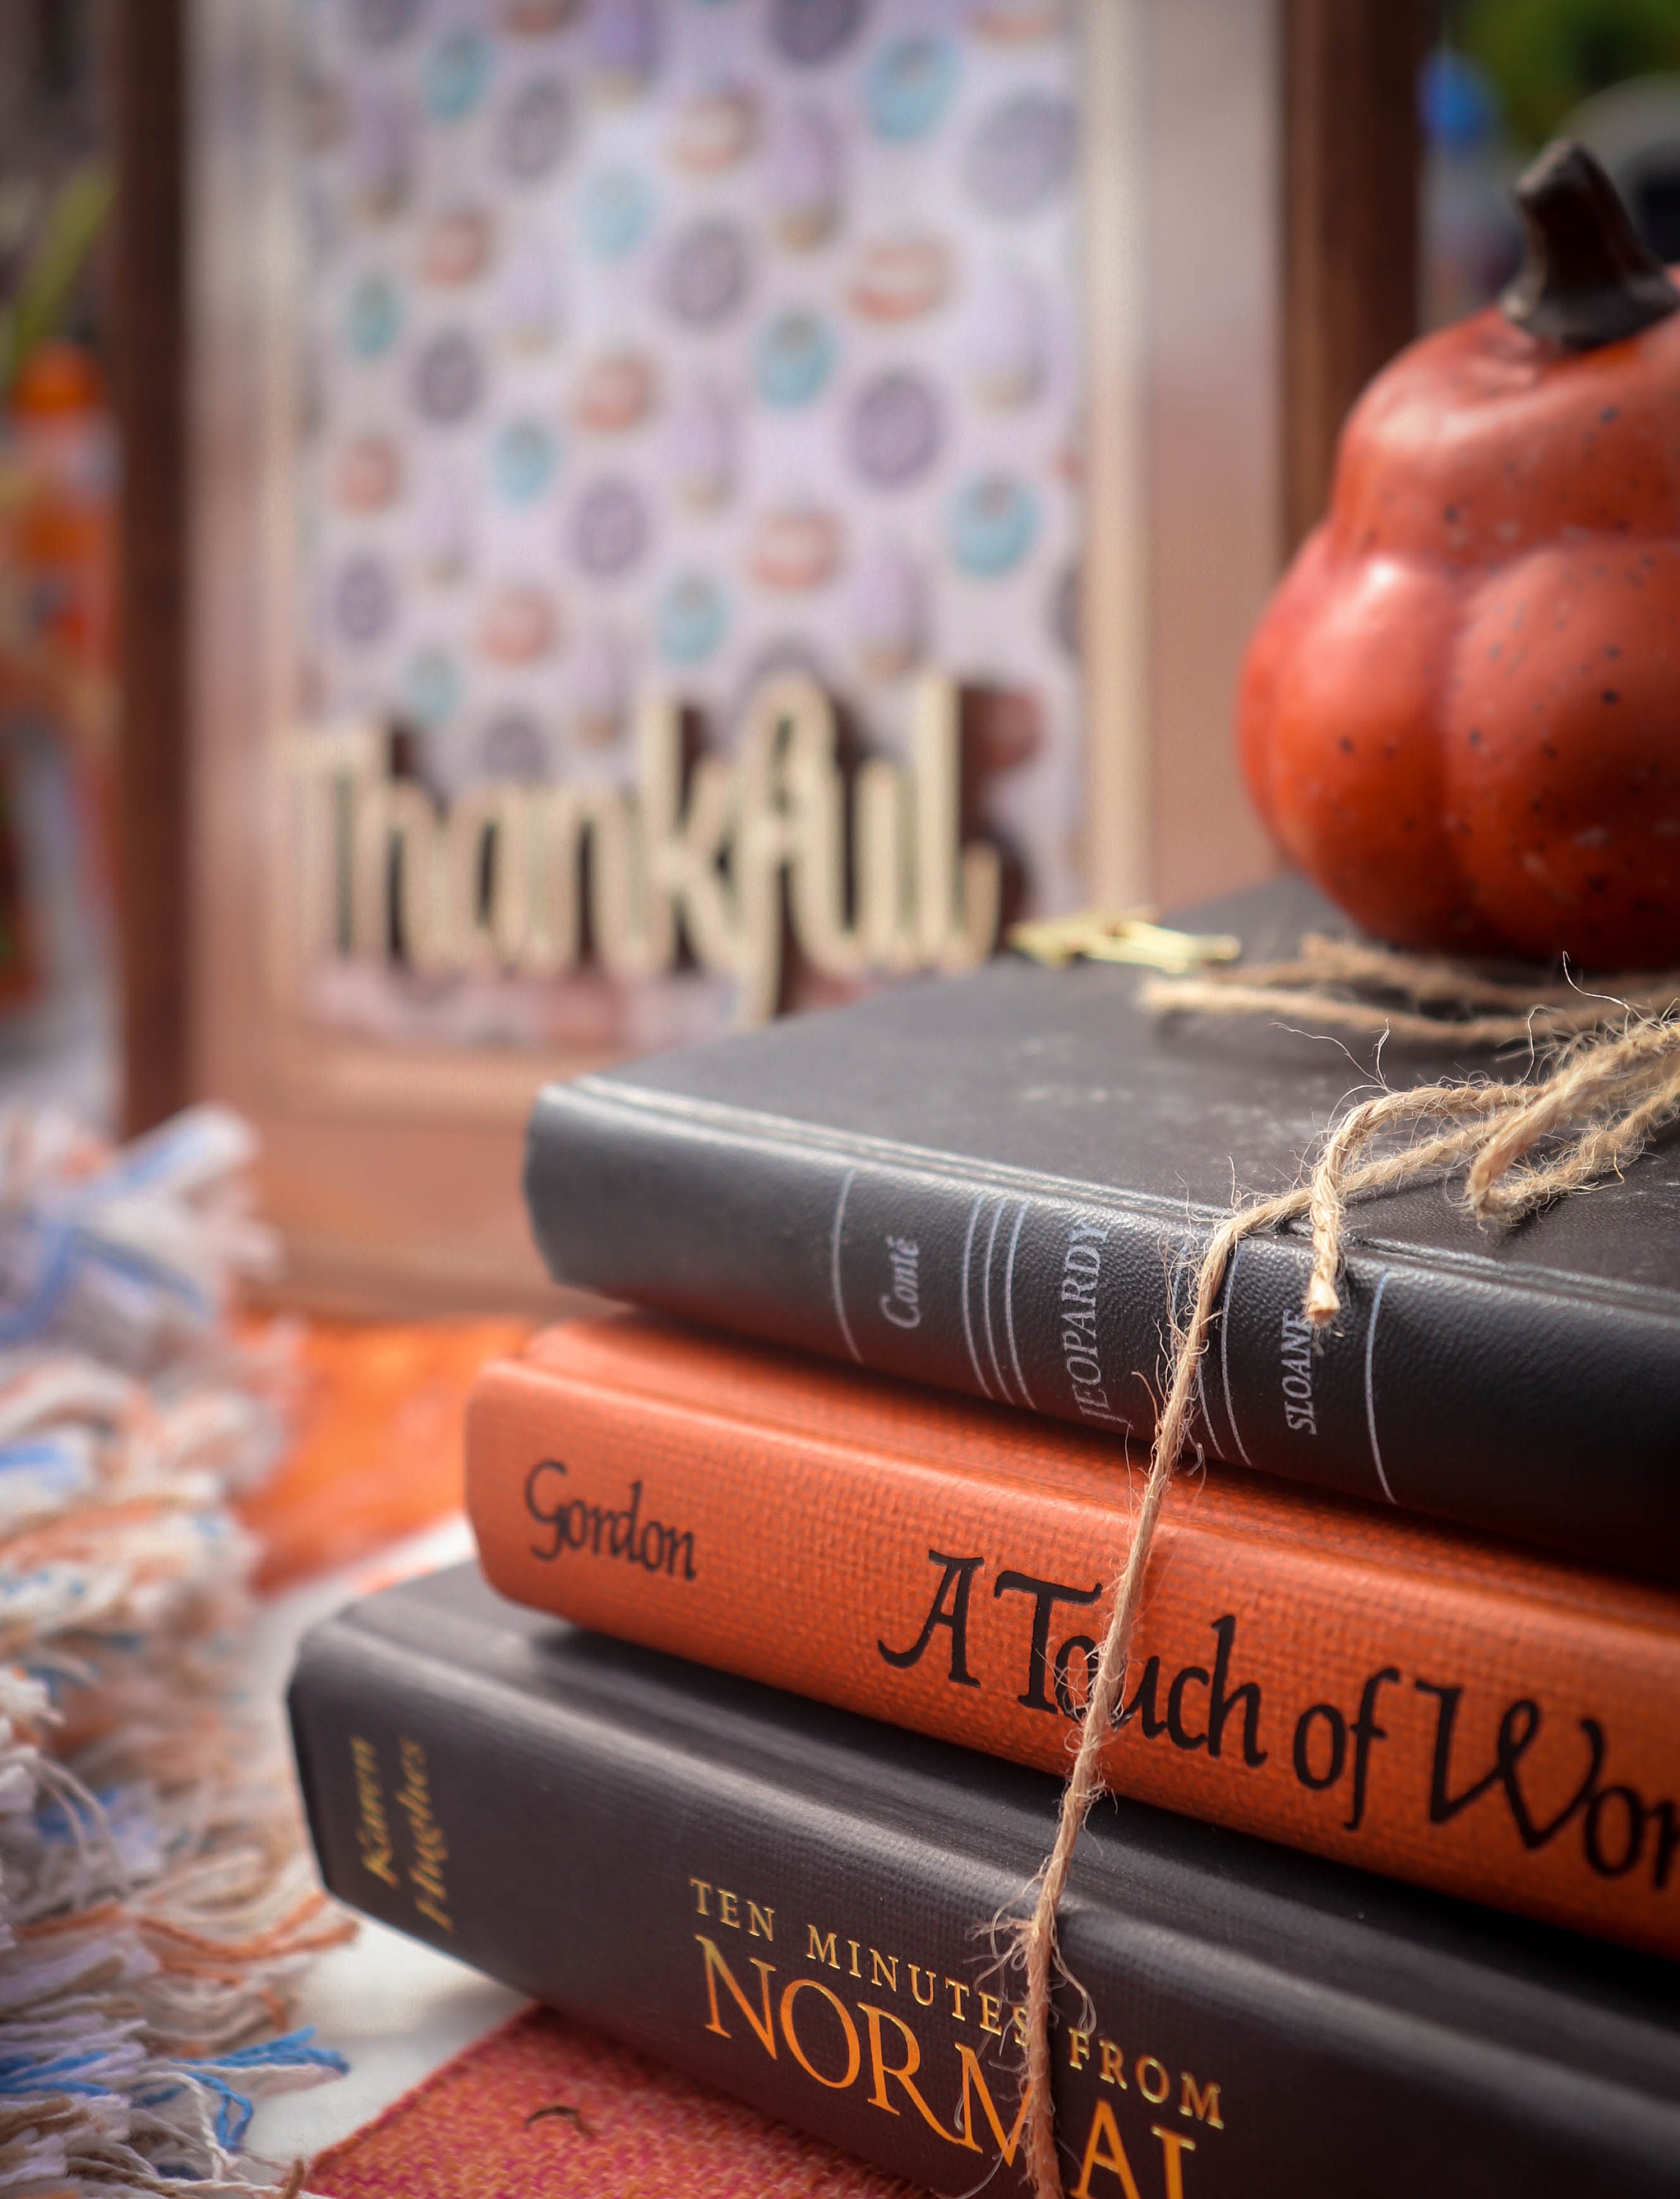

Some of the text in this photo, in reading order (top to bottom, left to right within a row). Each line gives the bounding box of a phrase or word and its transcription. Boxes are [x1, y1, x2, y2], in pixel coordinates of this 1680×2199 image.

[880, 1234, 921, 1329] Conté
[1061, 1221, 1135, 1431] JEOPARDY
[525, 1459, 697, 1582] Gordon
[877, 1549, 986, 1689] A
[993, 1569, 1268, 1768] Touch
[1293, 1668, 1401, 1832] of
[690, 1878, 1225, 2130] TEN MINUTES FROM
